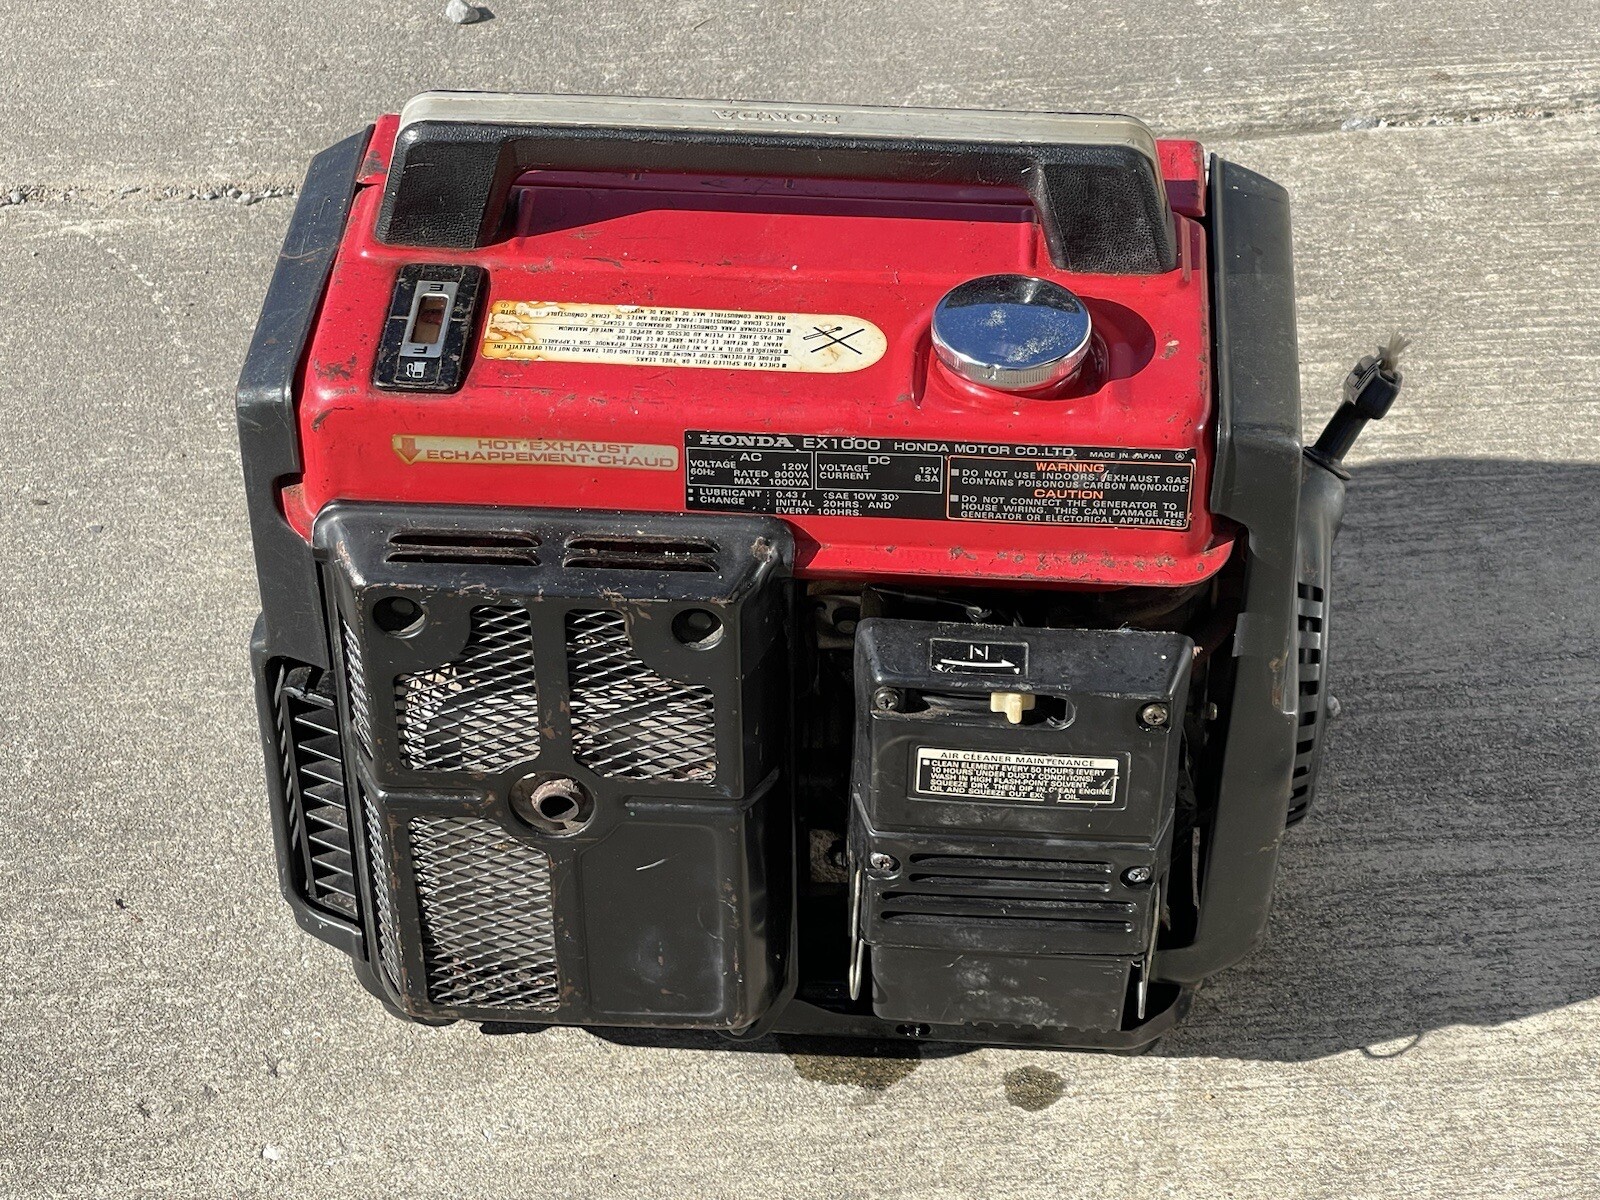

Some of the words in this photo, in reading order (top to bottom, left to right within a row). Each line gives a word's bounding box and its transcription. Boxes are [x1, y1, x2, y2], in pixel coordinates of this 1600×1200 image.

[712, 110, 841, 124] HONDA
[700, 434, 794, 448] HONDA
[803, 438, 880, 450] EX1000
[894, 442, 949, 452] HONDA
[955, 444, 1010, 454] MOTOR
[740, 453, 762, 461] AC
[868, 456, 890, 464] DC
[690, 460, 736, 469] VOLTAGE
[819, 464, 868, 472] VOLTAGE
[1036, 462, 1104, 472] WARNING
[690, 468, 715, 476] 60Hz
[962, 477, 1014, 486] CONTAINS
[1018, 480, 1079, 488] POISONOUS
[1083, 482, 1126, 490] CARBON
[1108, 474, 1160, 483] EXHAUST
[1166, 476, 1189, 484] GAS
[700, 488, 761, 497] LUBRICANT
[1034, 489, 1103, 499] CAUTION
[700, 496, 745, 505] CHANGE
[1010, 498, 1061, 506] CONNECT
[1093, 500, 1156, 509] GENERATOR
[1163, 502, 1177, 510] TO
[961, 503, 998, 511] HOUSE
[1004, 505, 1047, 514] WIRING.
[1054, 506, 1078, 514] THIS
[1113, 509, 1158, 517] DAMAGE
[961, 511, 1021, 520] GENERATOR
[1046, 514, 1114, 523] ELECTORICAL
[963, 753, 1011, 762] CLEANER
[1016, 757, 1095, 767] MAINTENANCE
[961, 762, 999, 770] ELEMENT
[930, 779, 968, 788] SQUEEZE
[994, 778, 1048, 786] FLASH-POINT
[968, 788, 1006, 796] SQUEEZE
